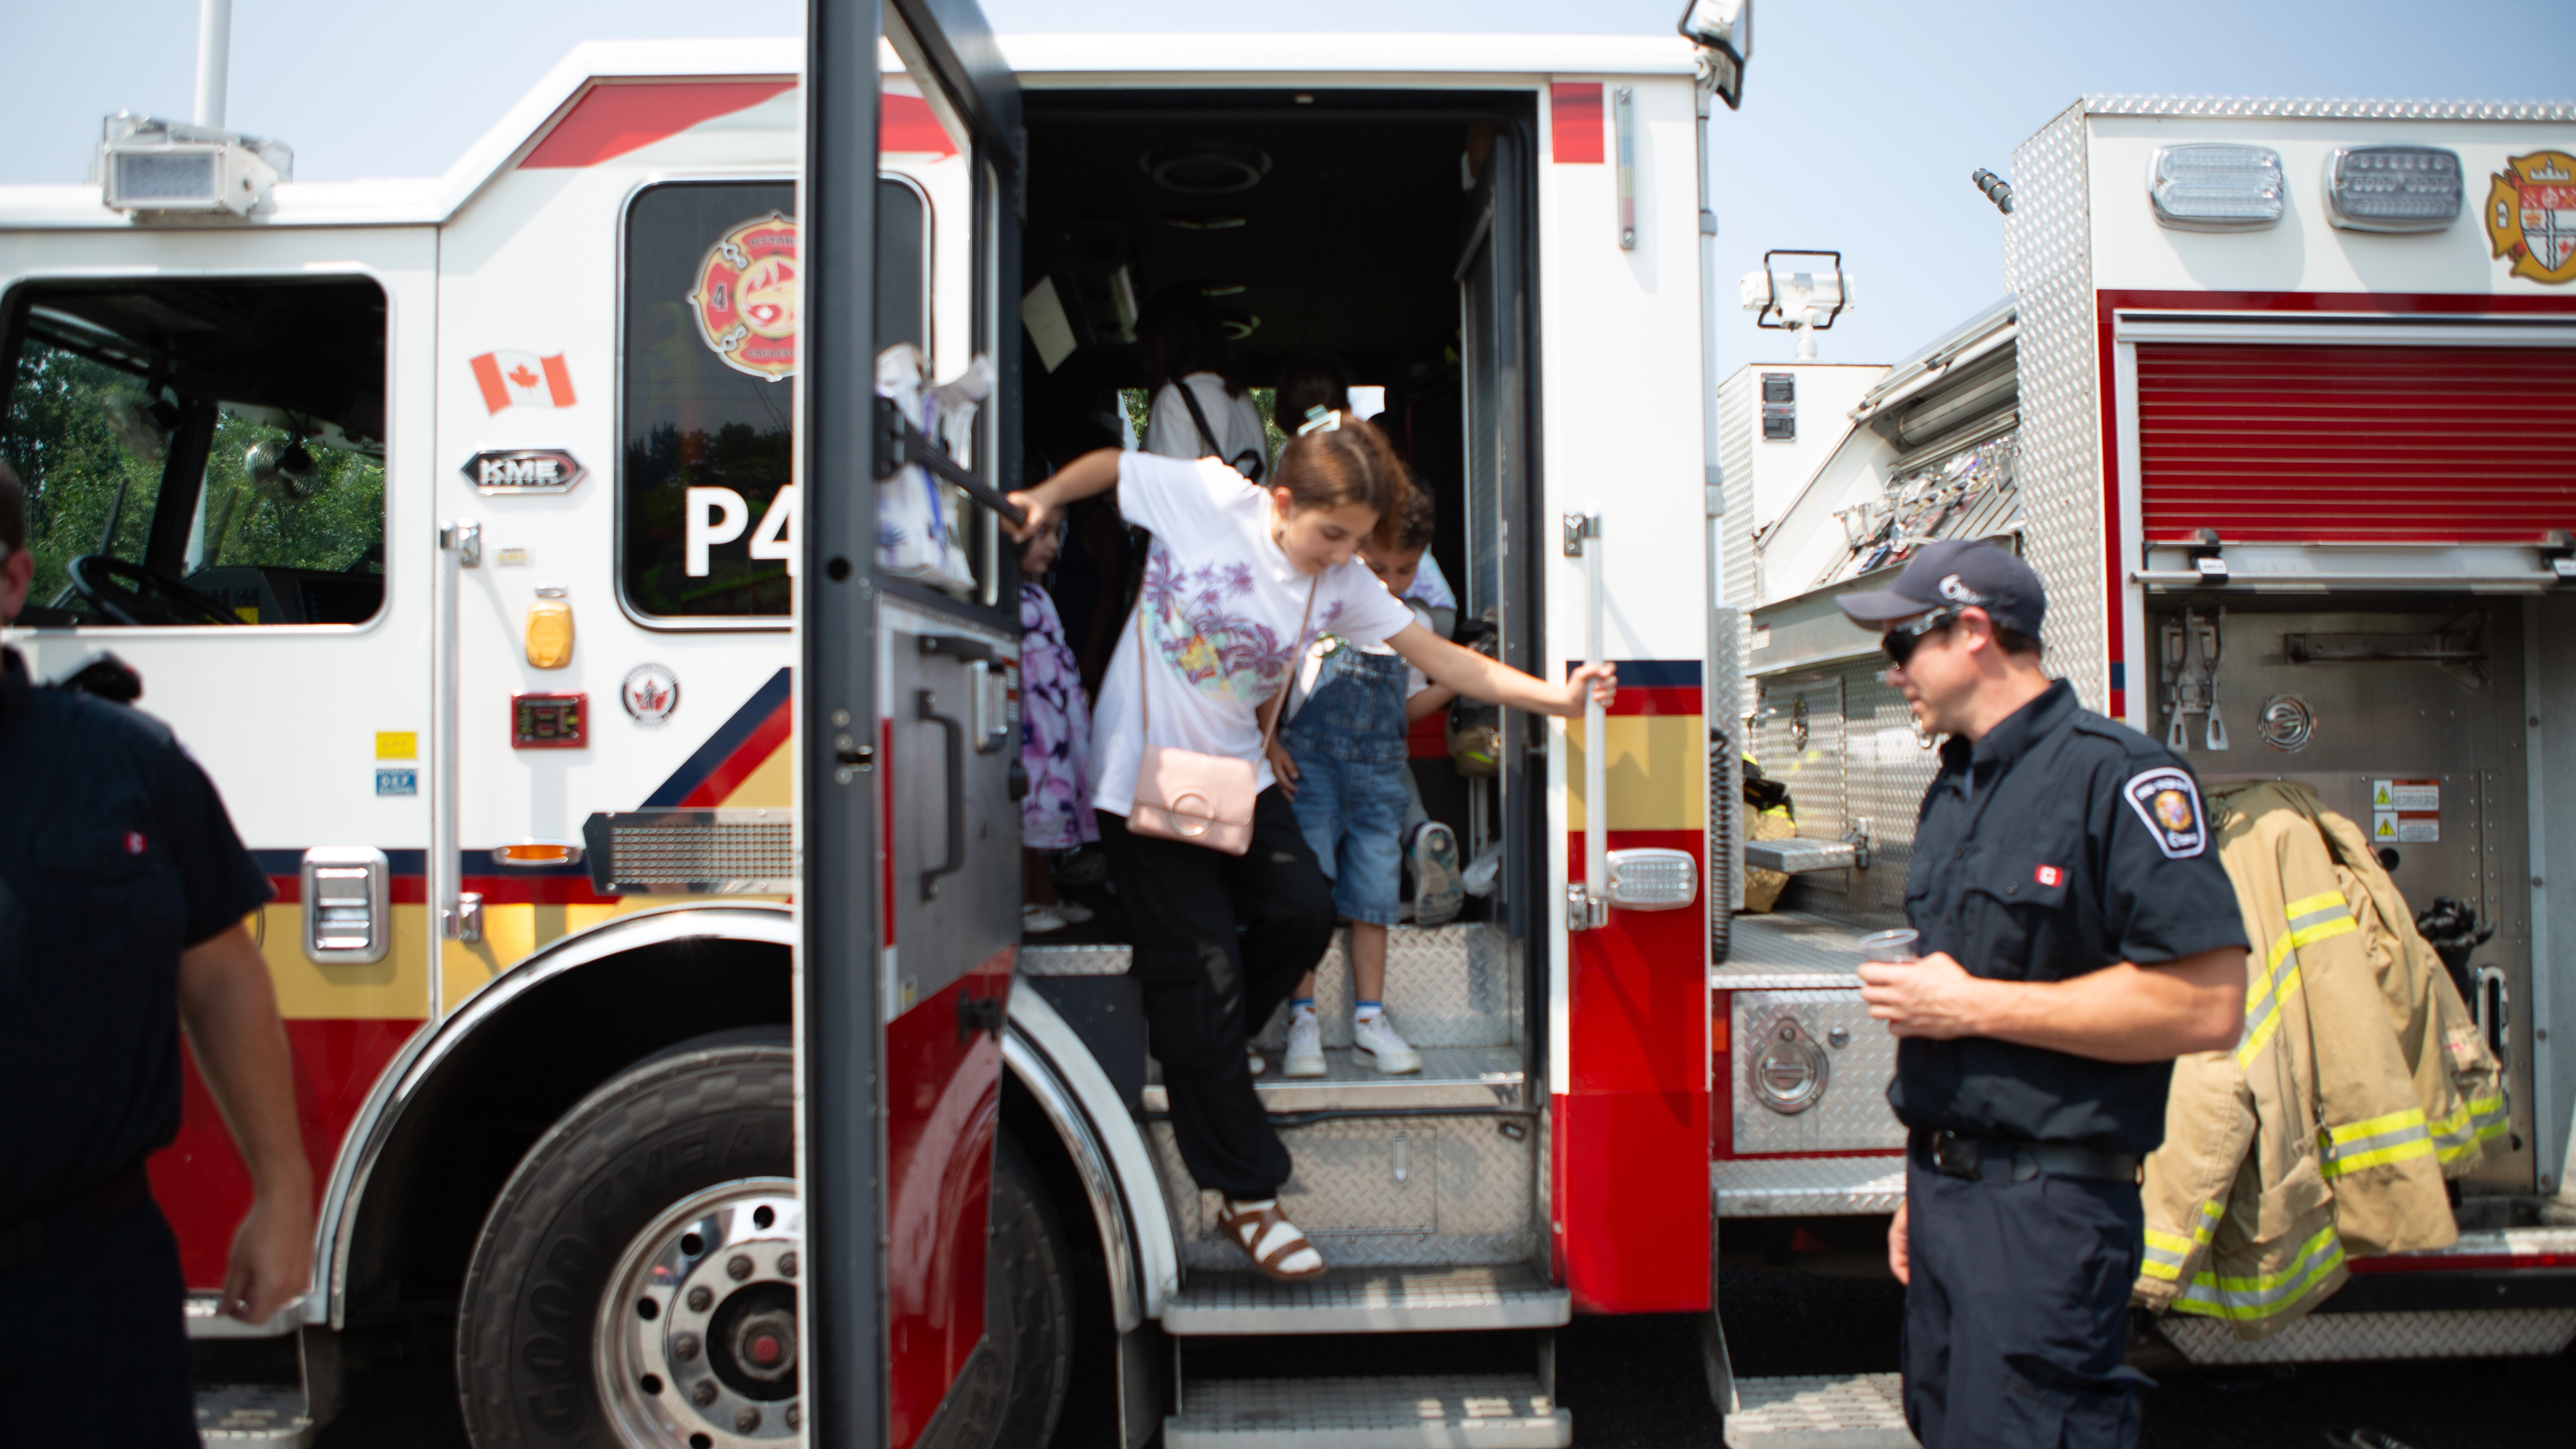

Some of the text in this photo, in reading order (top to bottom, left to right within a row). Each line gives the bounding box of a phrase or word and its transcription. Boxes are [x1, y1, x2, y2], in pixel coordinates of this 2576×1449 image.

[750, 235, 796, 248] OTTAW
[711, 281, 728, 312] 4
[479, 458, 559, 479] KME
[685, 485, 800, 577] P4
